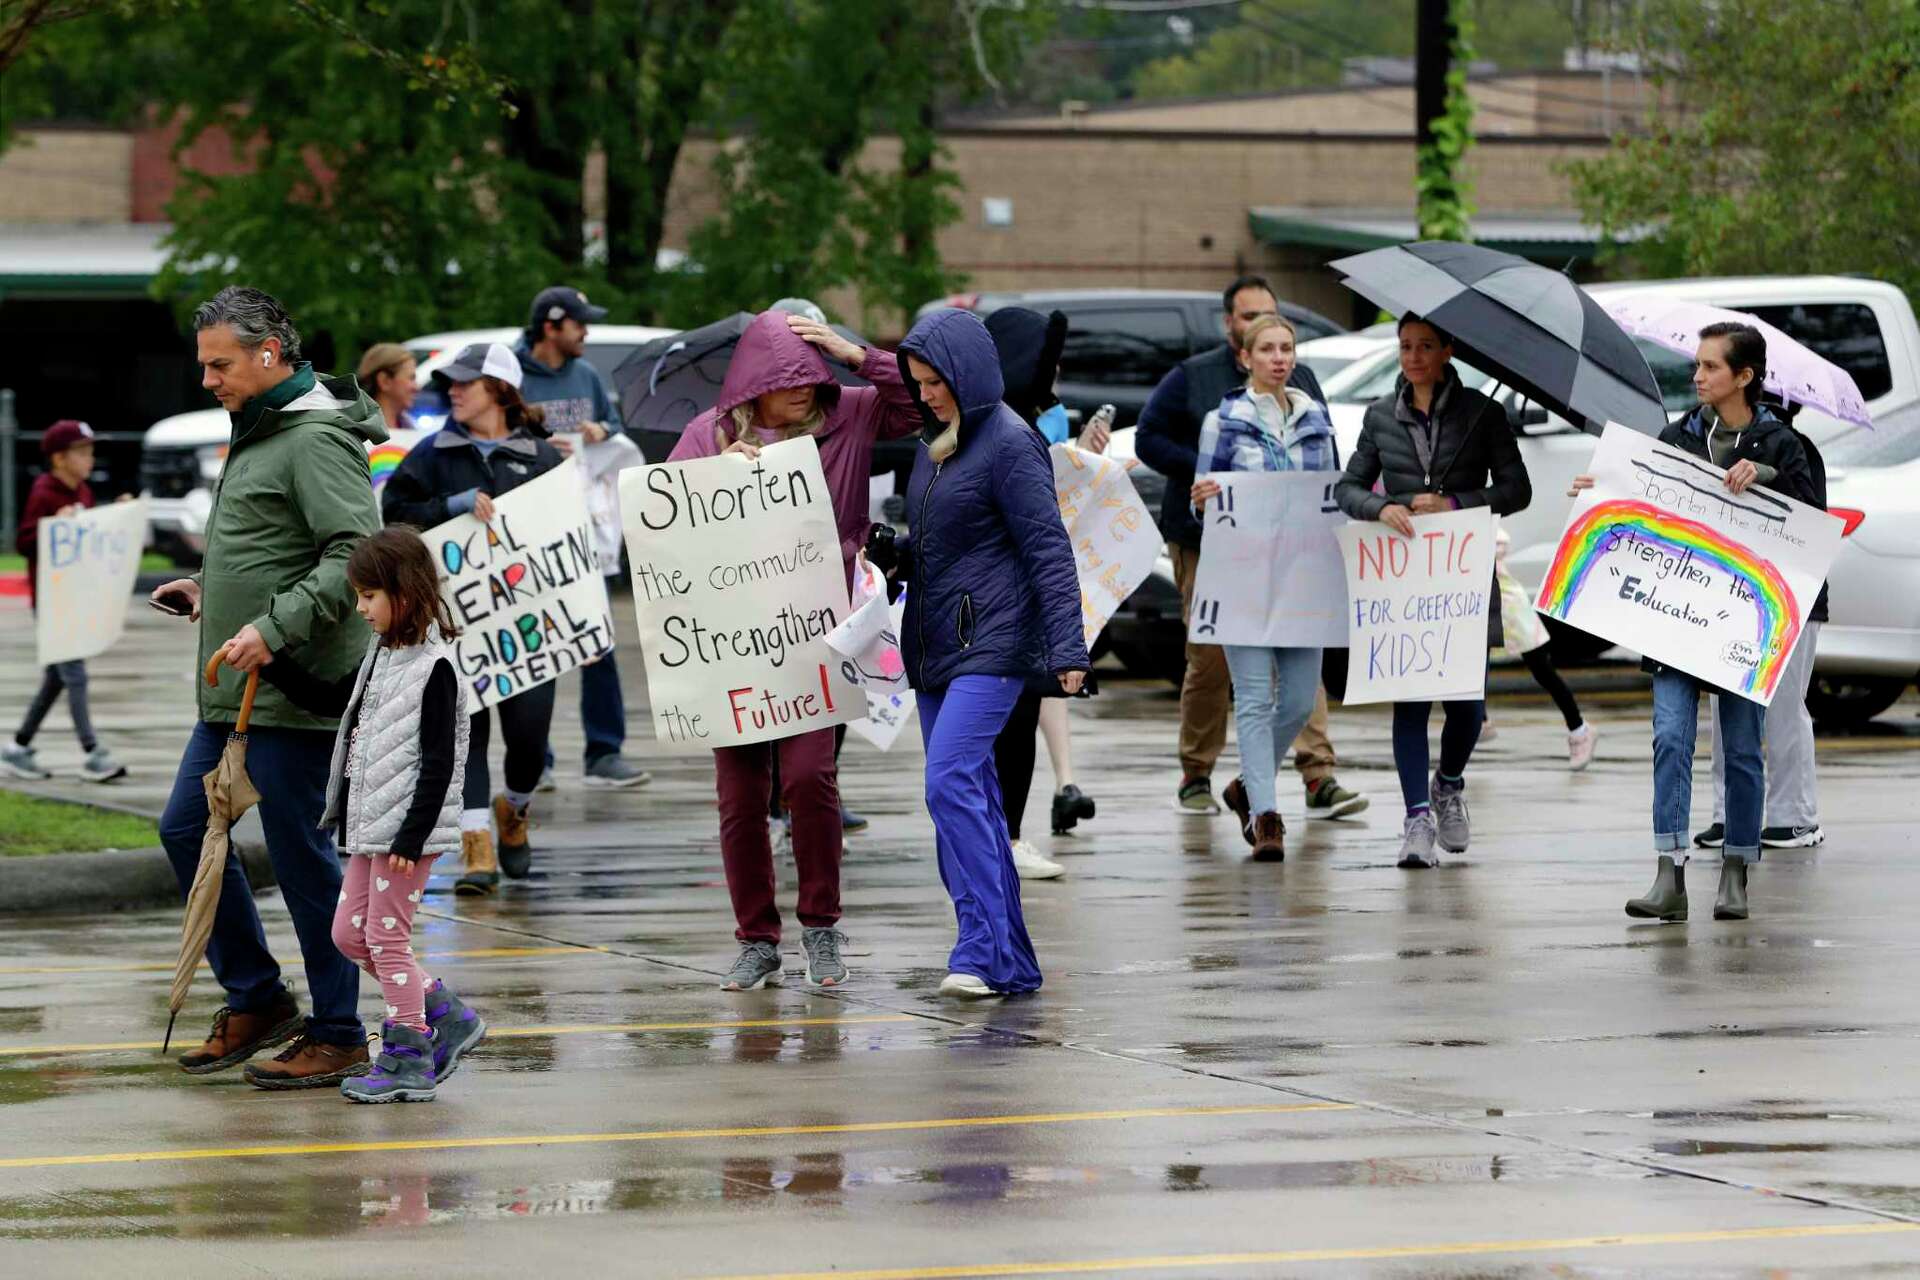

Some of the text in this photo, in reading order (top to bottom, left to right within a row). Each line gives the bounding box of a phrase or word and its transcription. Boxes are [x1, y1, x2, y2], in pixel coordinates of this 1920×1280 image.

[640, 461, 813, 531] Shorten
[1632, 471, 1708, 514] Shorten
[440, 514, 527, 583] OCAL
[637, 537, 825, 602] the commute,
[1358, 535, 1409, 582] NO
[1422, 530, 1474, 577] TIC
[1606, 522, 1756, 603] Strengthen the
[455, 599, 588, 677] GLOBAL
[659, 602, 838, 668] Strengthen
[1353, 590, 1483, 628] FOR CREEKSIDE
[1368, 623, 1452, 680] KIDS!
[660, 703, 710, 743] the
[727, 662, 838, 735] Future!
